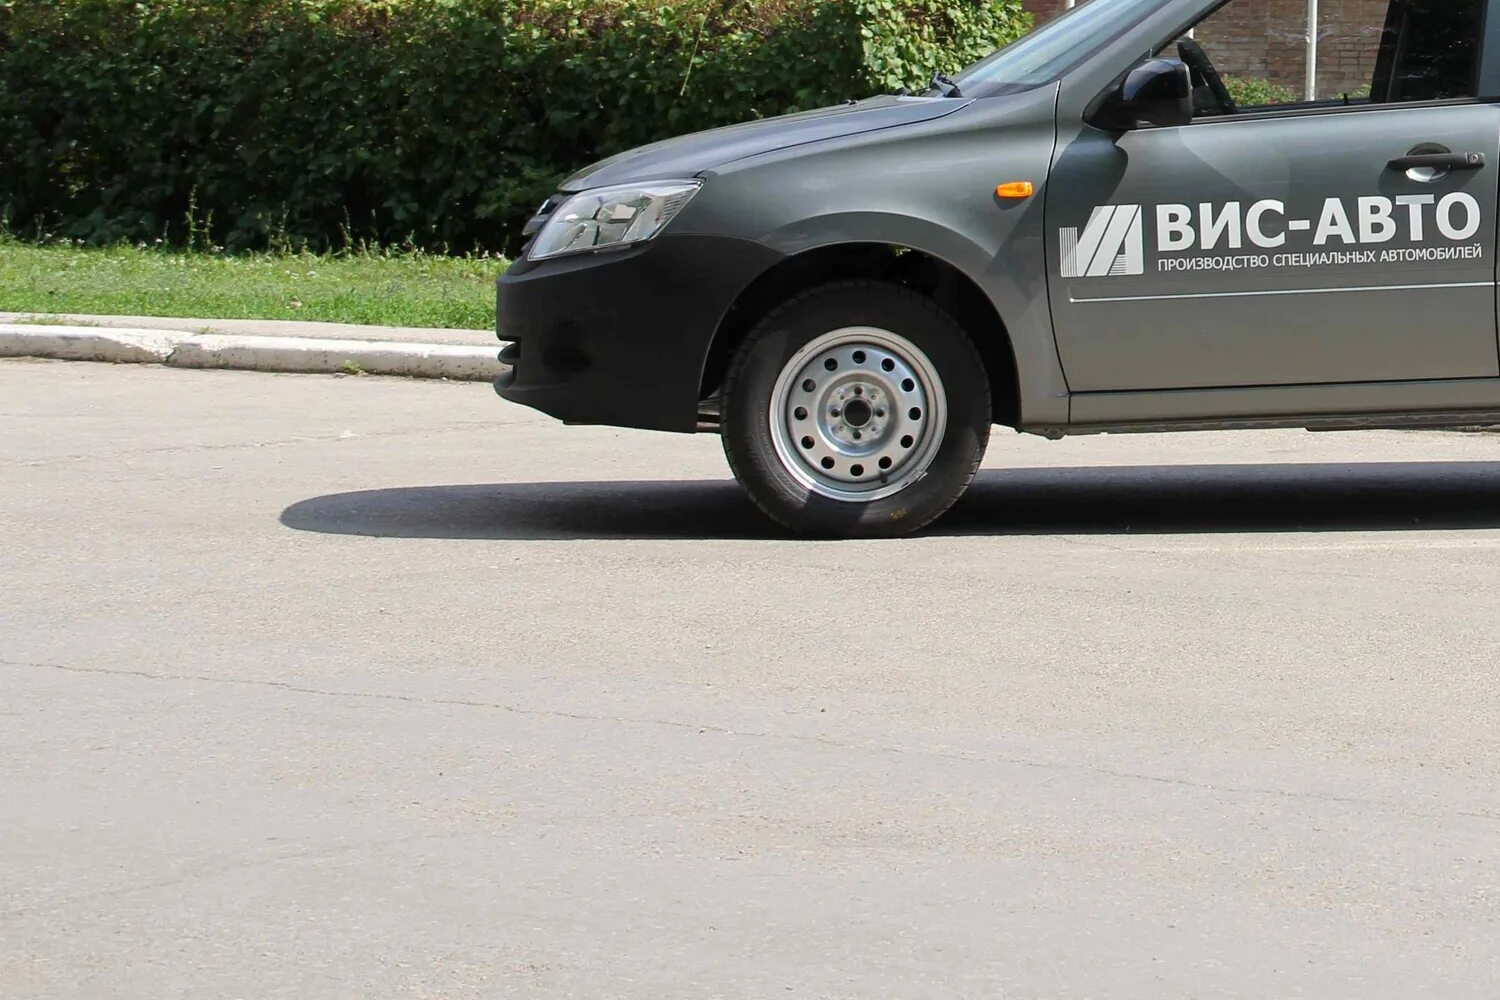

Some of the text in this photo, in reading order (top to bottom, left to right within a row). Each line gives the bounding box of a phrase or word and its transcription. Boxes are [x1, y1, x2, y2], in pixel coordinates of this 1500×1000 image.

[1155, 191, 1482, 252] ВИС-АВТО
[1158, 243, 1482, 271] ПРОИЗВОДСТВО СПЕЦИАЛЬНЫХ АВТОМОБИЛЕЙ
